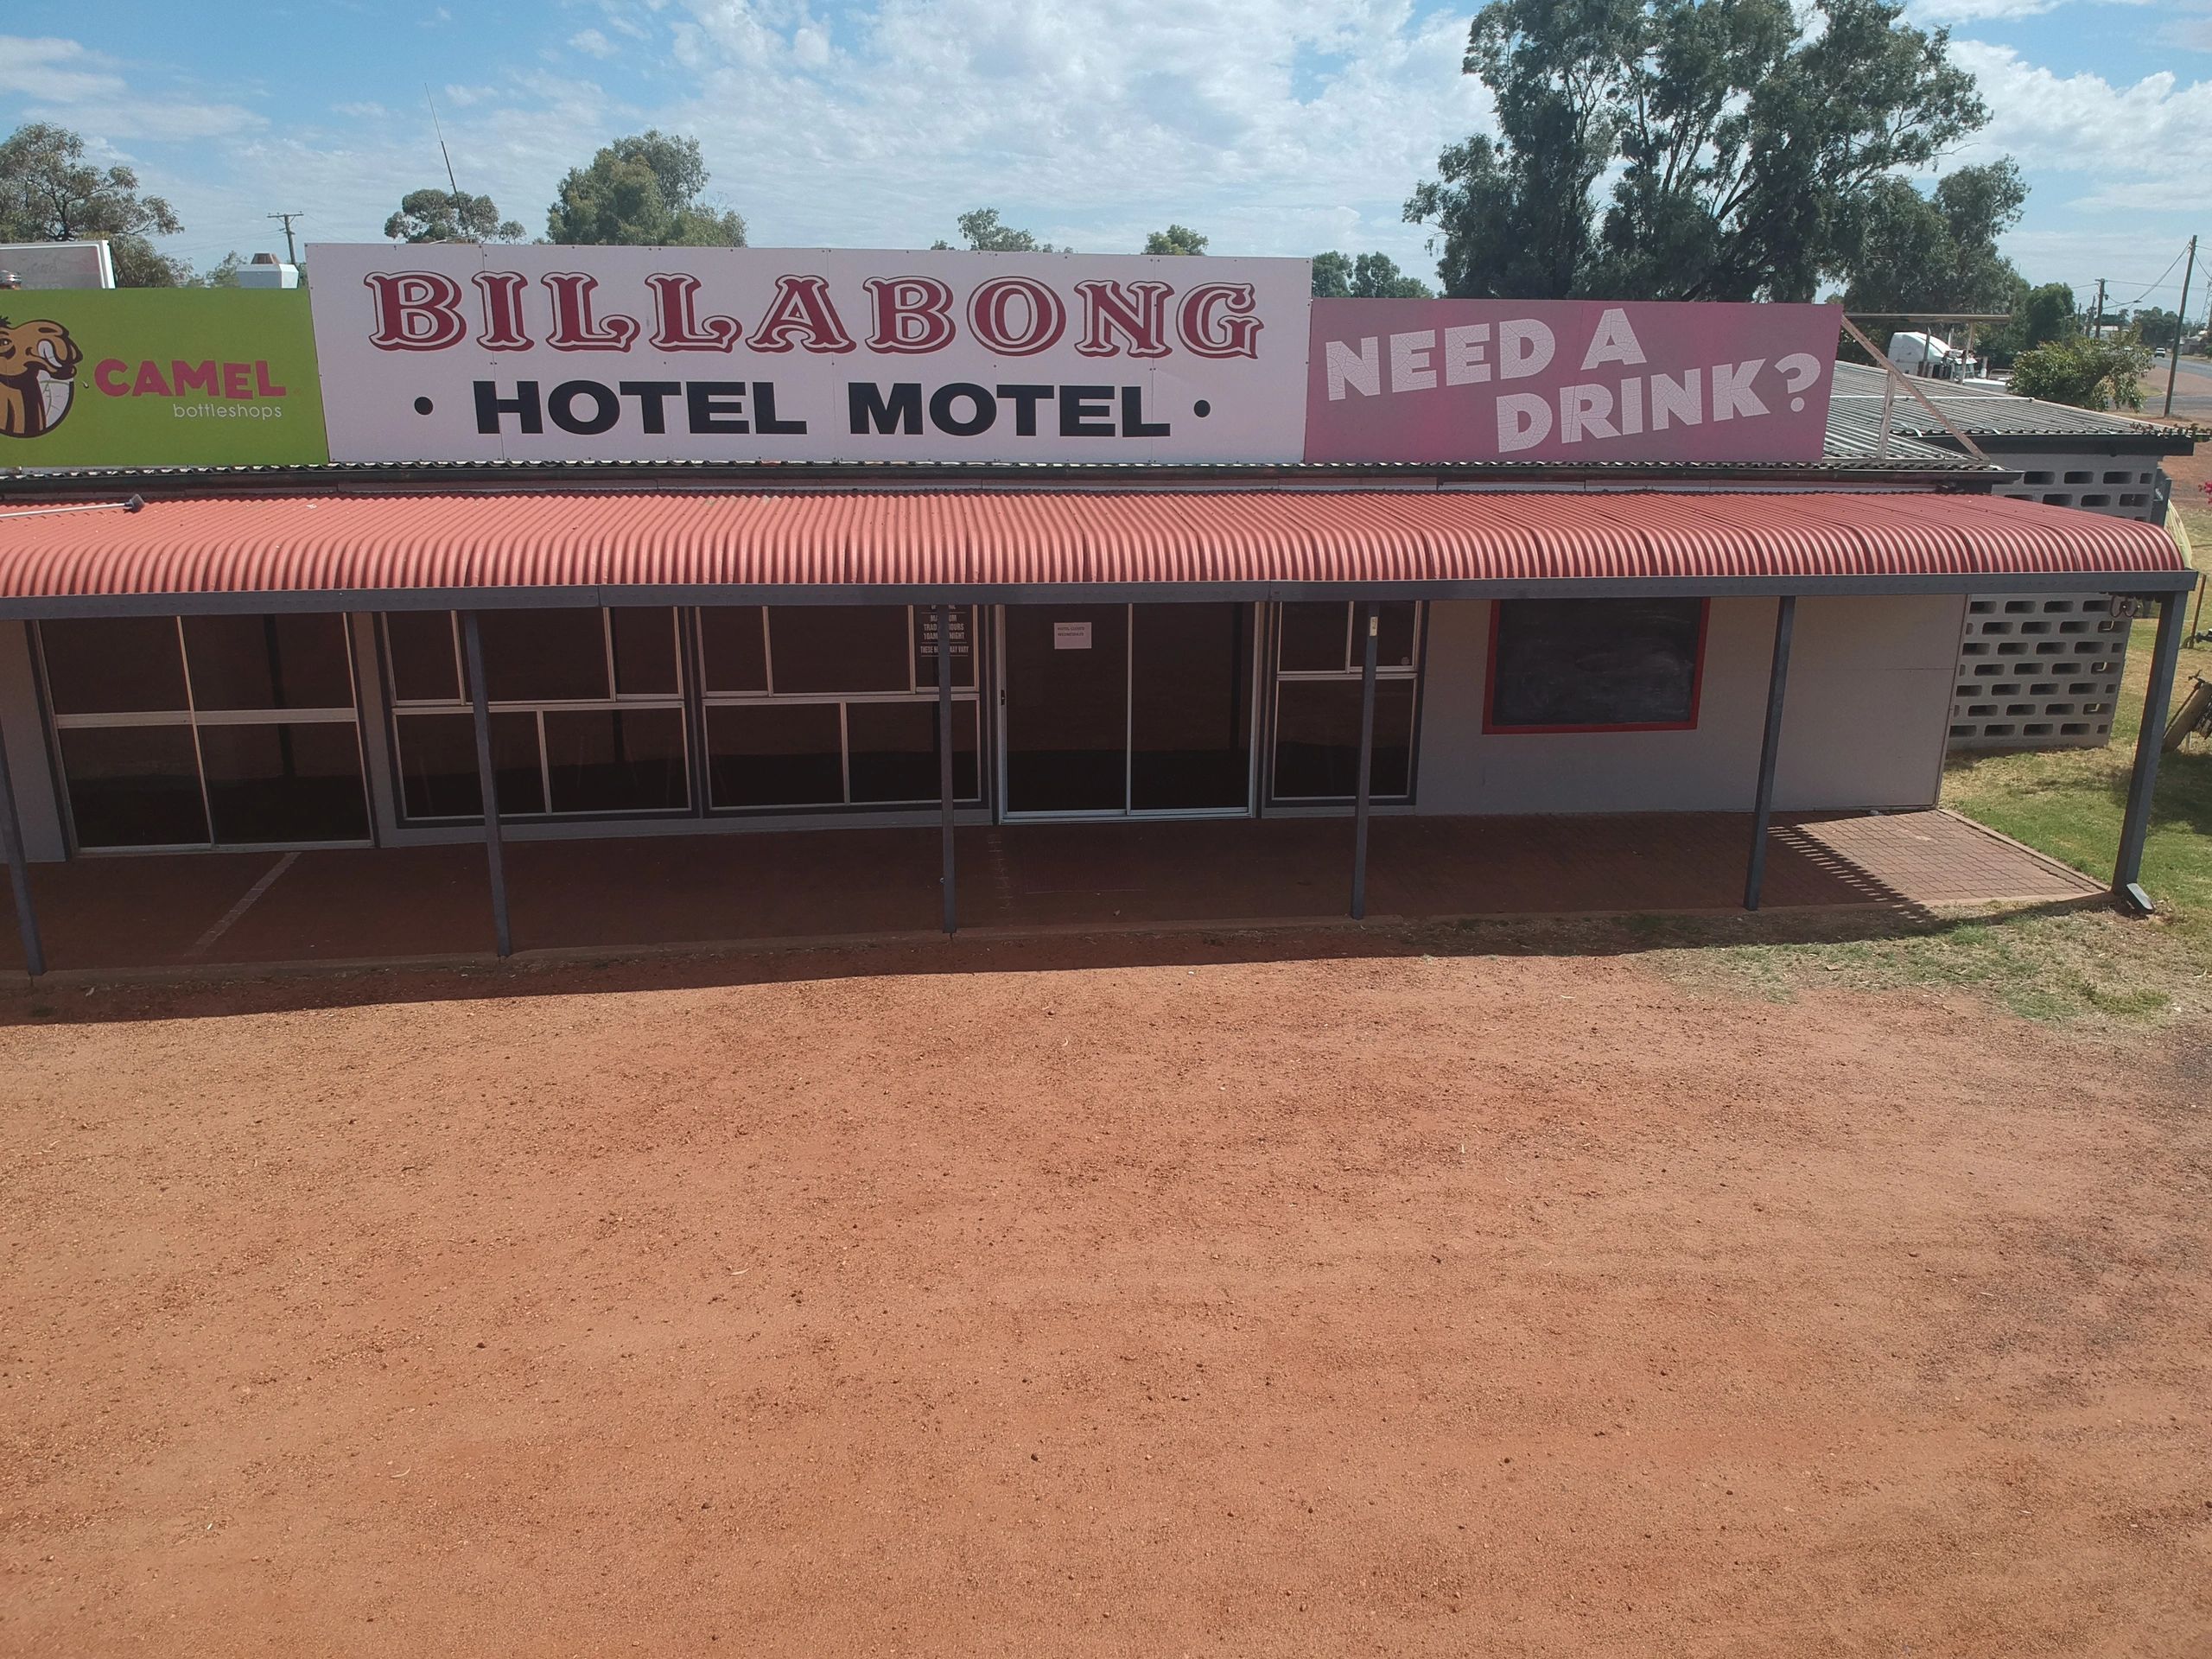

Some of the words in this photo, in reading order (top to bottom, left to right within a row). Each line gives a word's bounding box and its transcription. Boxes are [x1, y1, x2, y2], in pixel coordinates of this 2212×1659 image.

[363, 270, 1264, 359] BILLABONG
[94, 359, 287, 400] CAMEL
[1325, 318, 1555, 401] NEED
[1580, 308, 1647, 371] A
[173, 404, 283, 421] bottleshops
[473, 380, 808, 435] HOTEL
[848, 382, 1171, 437] MOTEL
[1496, 353, 1821, 454] DRINK?
